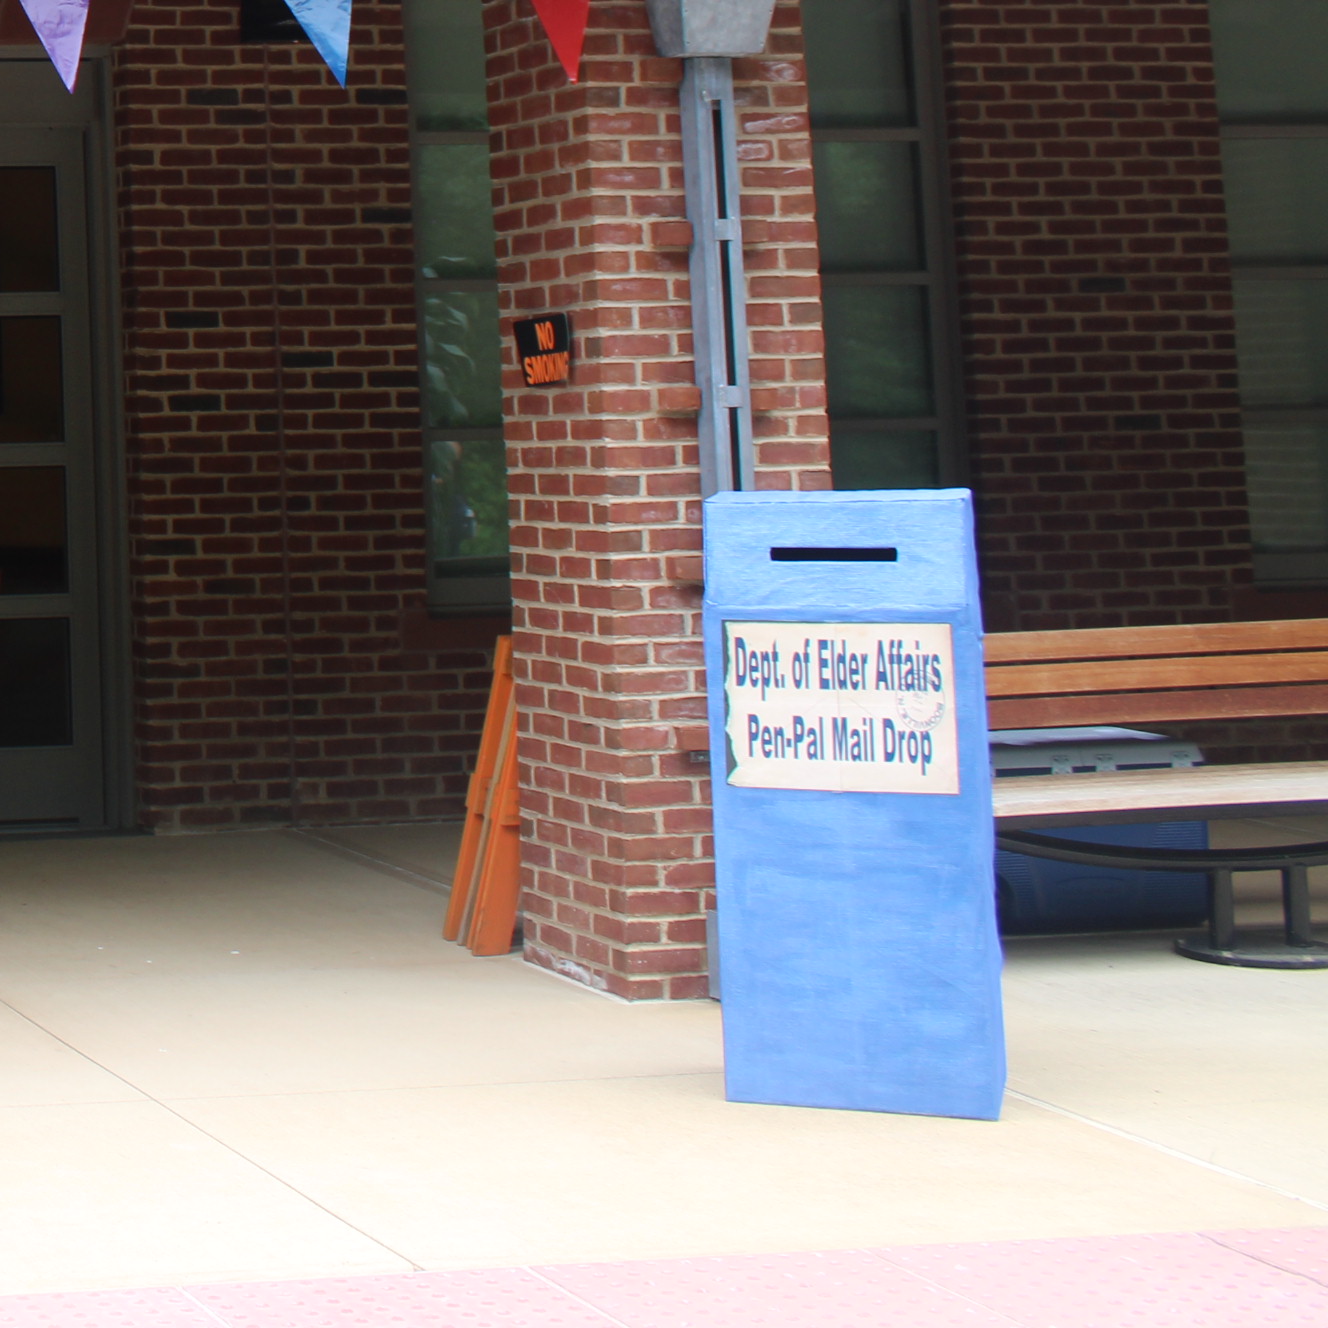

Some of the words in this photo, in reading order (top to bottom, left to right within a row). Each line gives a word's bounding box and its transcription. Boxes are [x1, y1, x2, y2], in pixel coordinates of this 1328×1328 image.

[534, 321, 556, 351] NO
[524, 351, 569, 384] SMOKING
[734, 637, 785, 701] Dept.
[792, 638, 810, 689] of
[817, 639, 868, 690] Elder
[875, 640, 942, 692] Affairs
[747, 714, 825, 760] Pen-Pal
[832, 717, 875, 762] Mail
[882, 718, 932, 776] Drop
